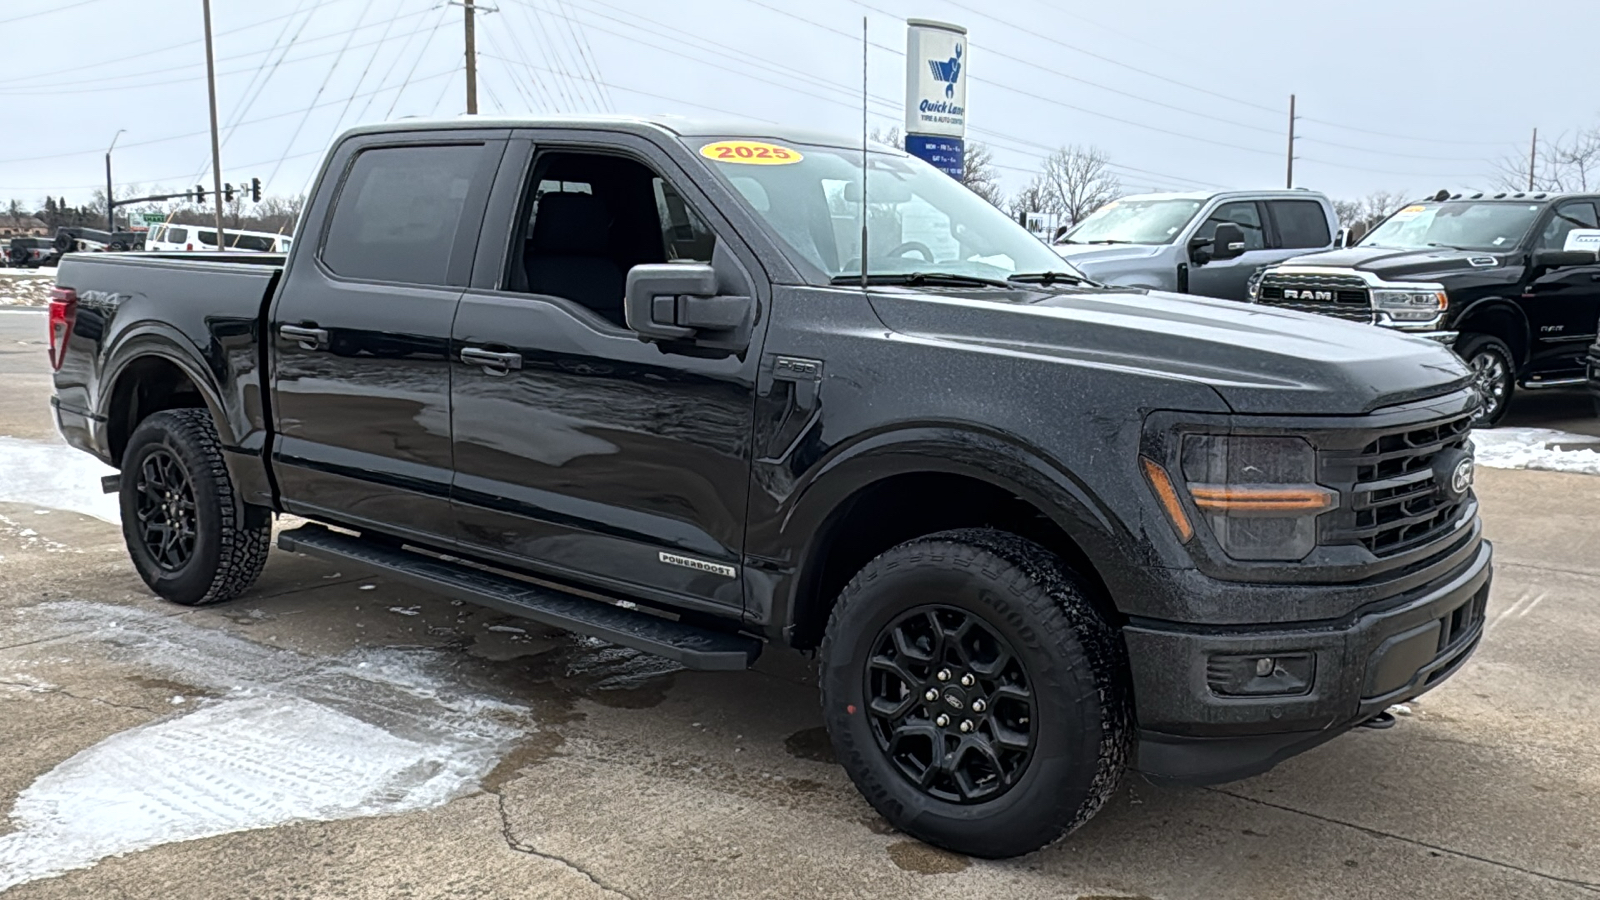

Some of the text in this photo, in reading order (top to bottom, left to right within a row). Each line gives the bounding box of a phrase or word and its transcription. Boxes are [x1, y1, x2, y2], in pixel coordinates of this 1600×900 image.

[919, 99, 947, 113] Quick
[714, 146, 791, 160] 2025
[1284, 289, 1332, 301] RAM
[661, 554, 732, 576] POWERBOOST
